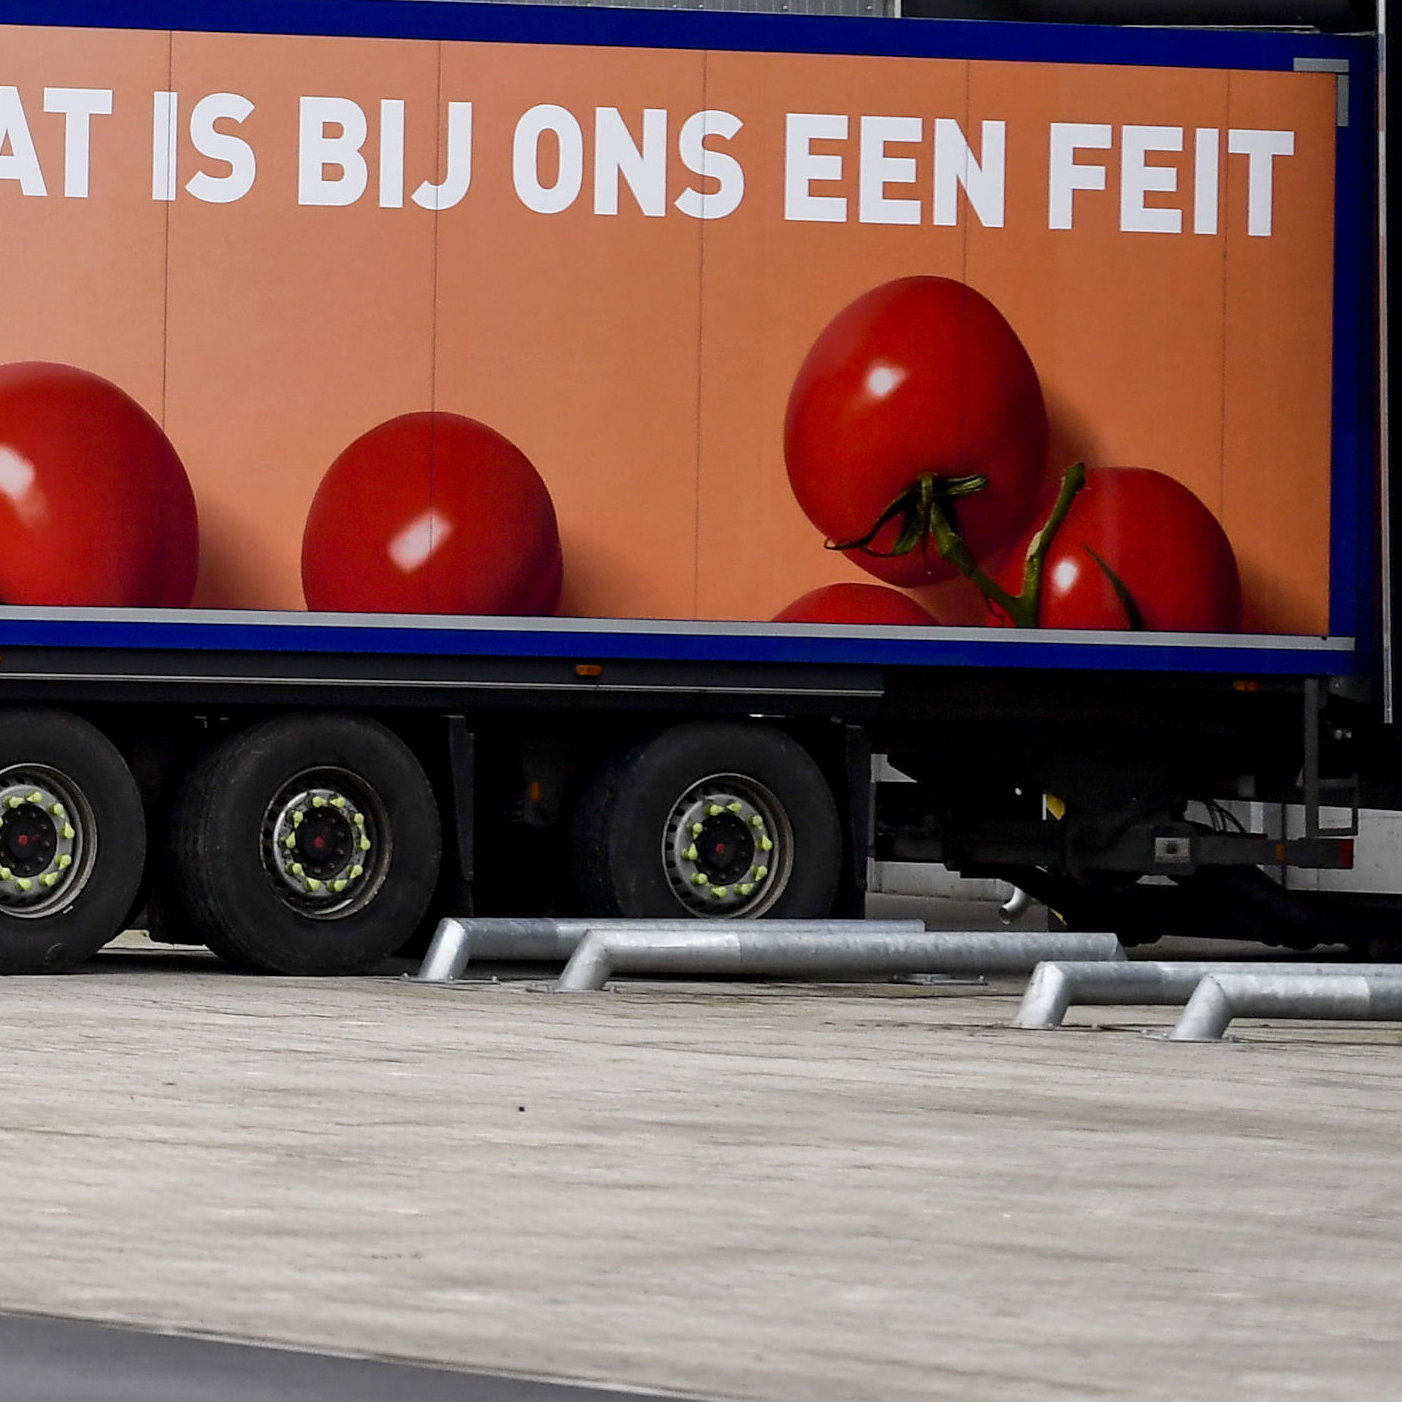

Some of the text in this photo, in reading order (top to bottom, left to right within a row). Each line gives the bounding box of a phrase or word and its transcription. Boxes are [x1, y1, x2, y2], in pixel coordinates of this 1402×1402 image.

[152, 91, 256, 204] IS
[298, 96, 473, 211] BIJ
[512, 104, 744, 219] ONS
[784, 113, 1006, 228] EEN
[1049, 122, 1294, 237] FEIT
